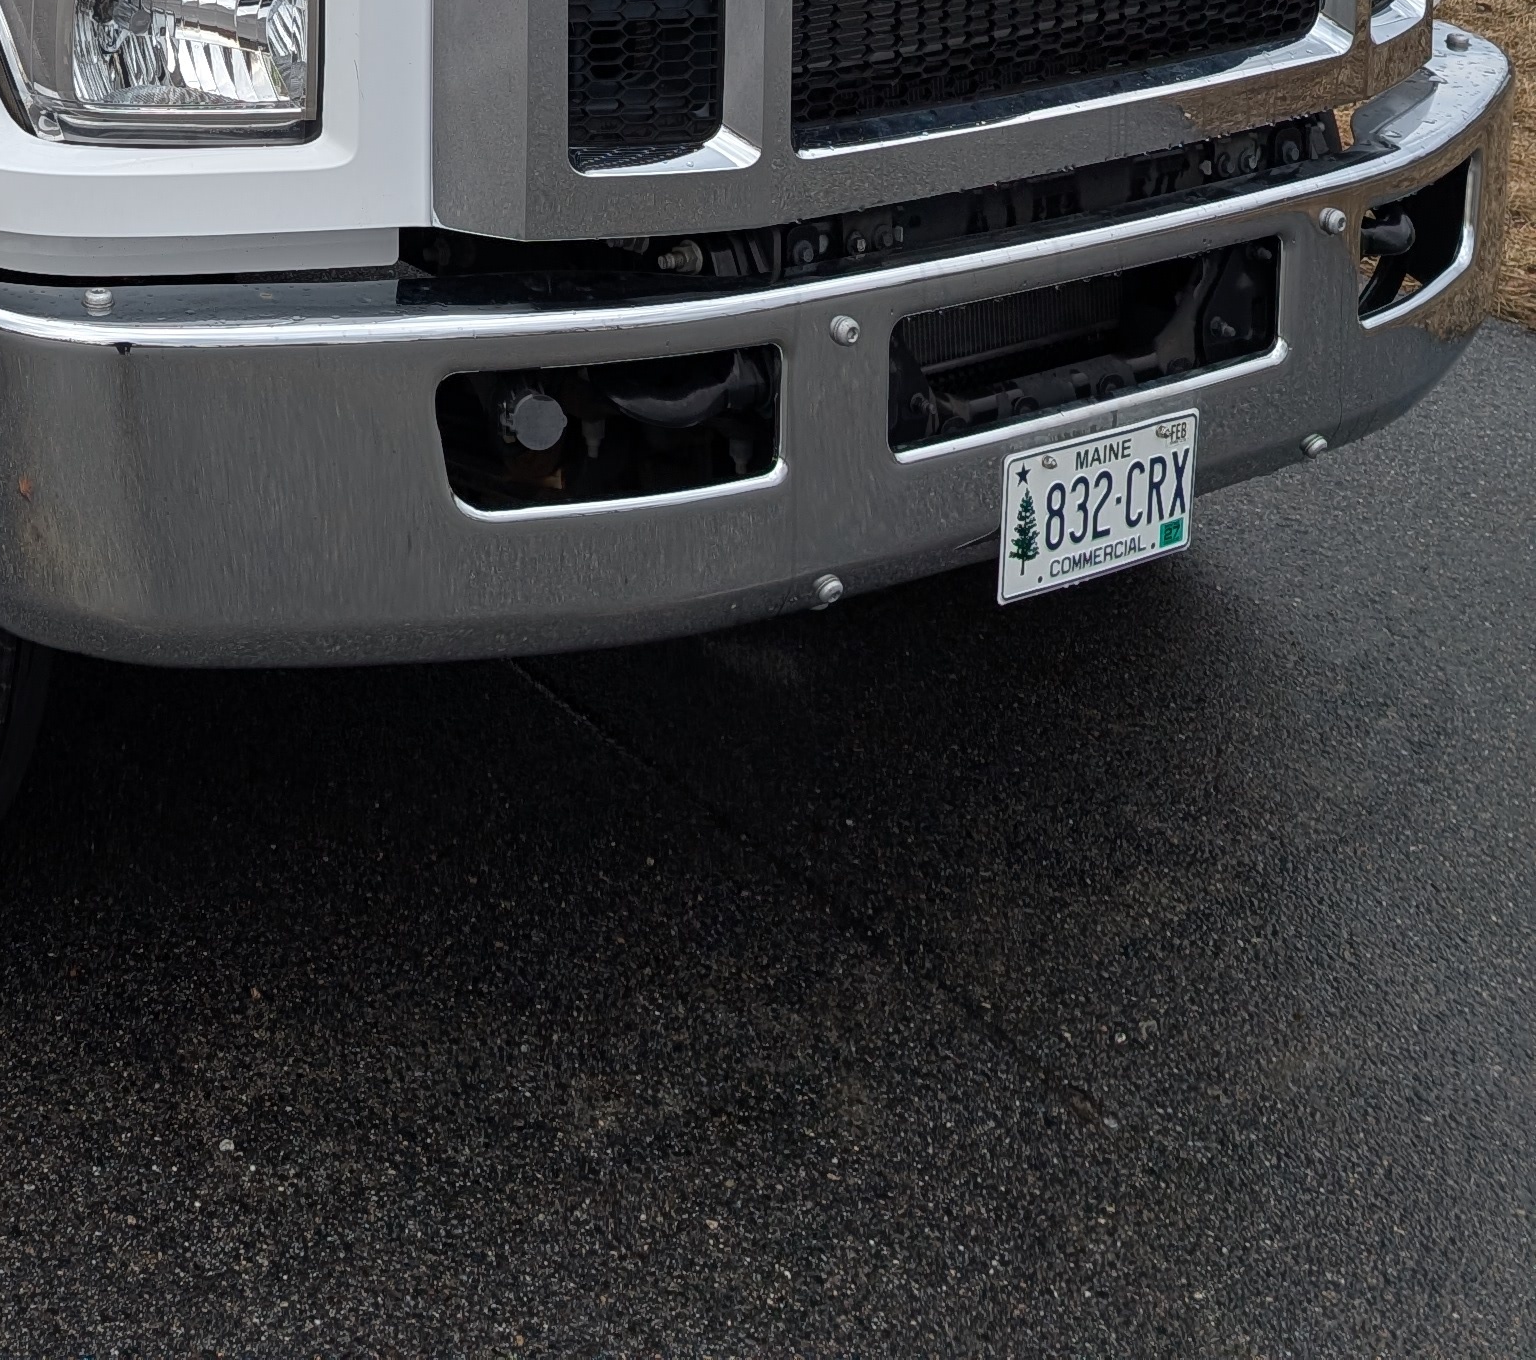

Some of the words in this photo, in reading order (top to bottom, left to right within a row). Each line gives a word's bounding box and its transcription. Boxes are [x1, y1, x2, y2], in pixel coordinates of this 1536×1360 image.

[1170, 421, 1188, 443] FEB
[1075, 438, 1133, 472] MAINE
[1049, 534, 1147, 579] COMMERCIAL
